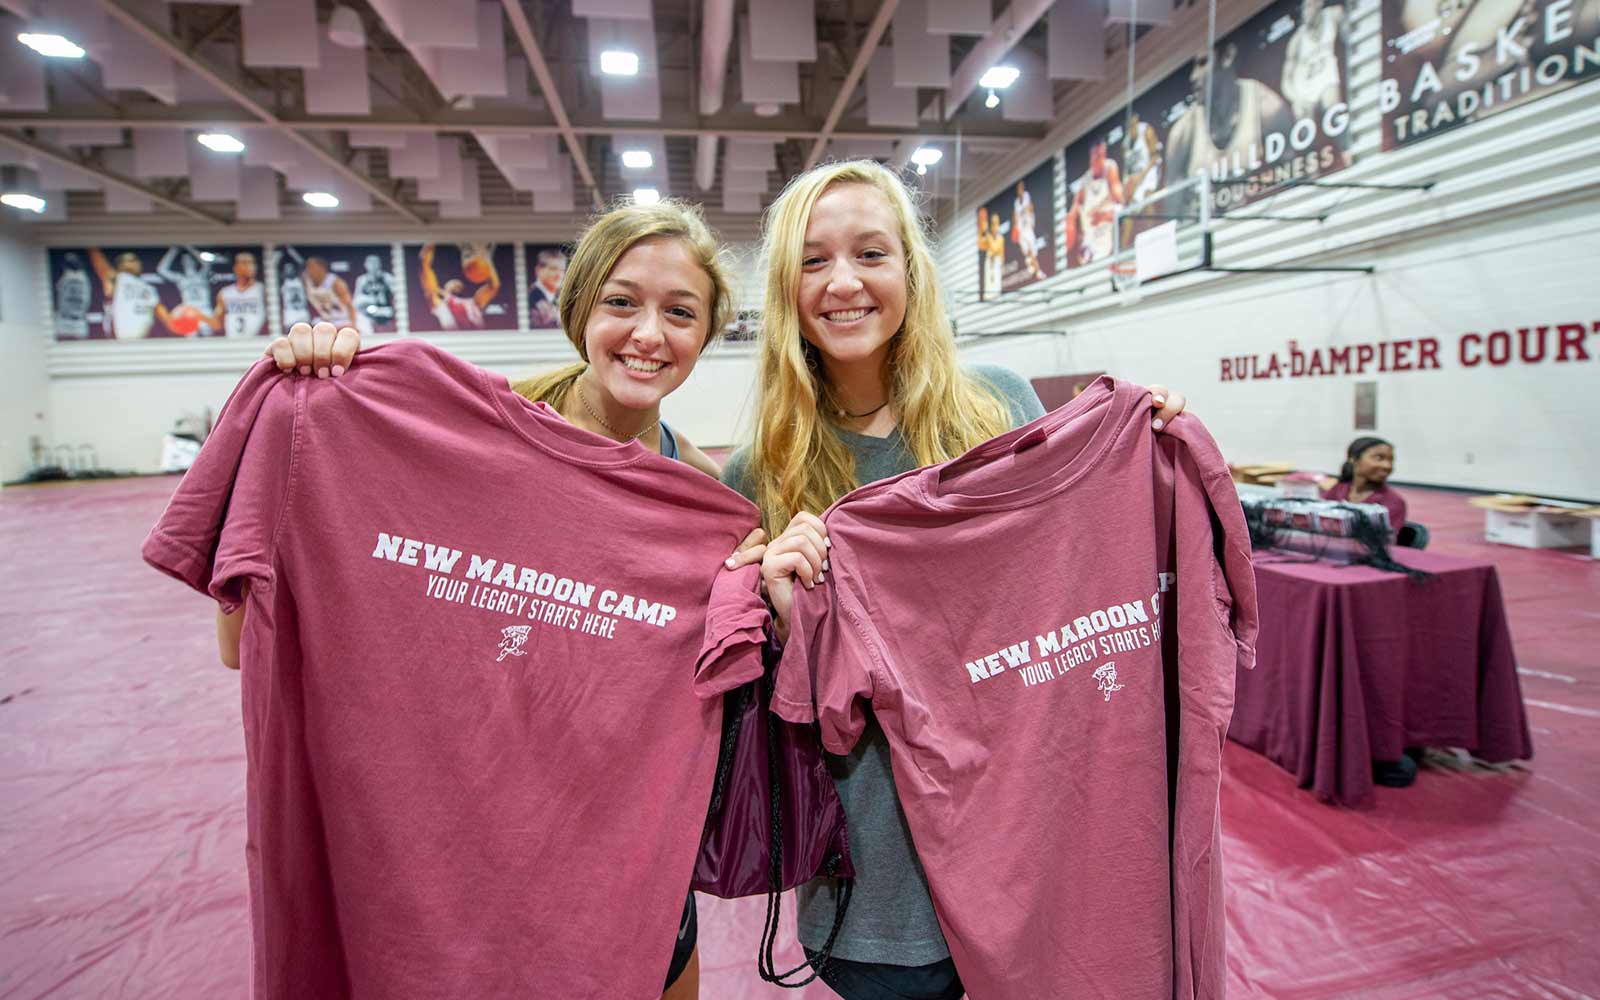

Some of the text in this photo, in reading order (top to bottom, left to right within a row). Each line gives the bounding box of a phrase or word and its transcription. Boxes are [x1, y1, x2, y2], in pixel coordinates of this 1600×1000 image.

[1208, 102, 1349, 183] ULLDOG
[1220, 321, 1600, 381] RULA-DAMPIER COUR
[372, 533, 677, 627] NEW MAROON CAMP
[425, 575, 618, 639] YOUR LEGACY STARTS HERE
[965, 640, 1031, 683] NEW
[1035, 600, 1148, 657] MAROON
[1018, 660, 1055, 687] YOUR
[1054, 642, 1098, 676] LEGACY
[1099, 628, 1151, 656] STARTS
